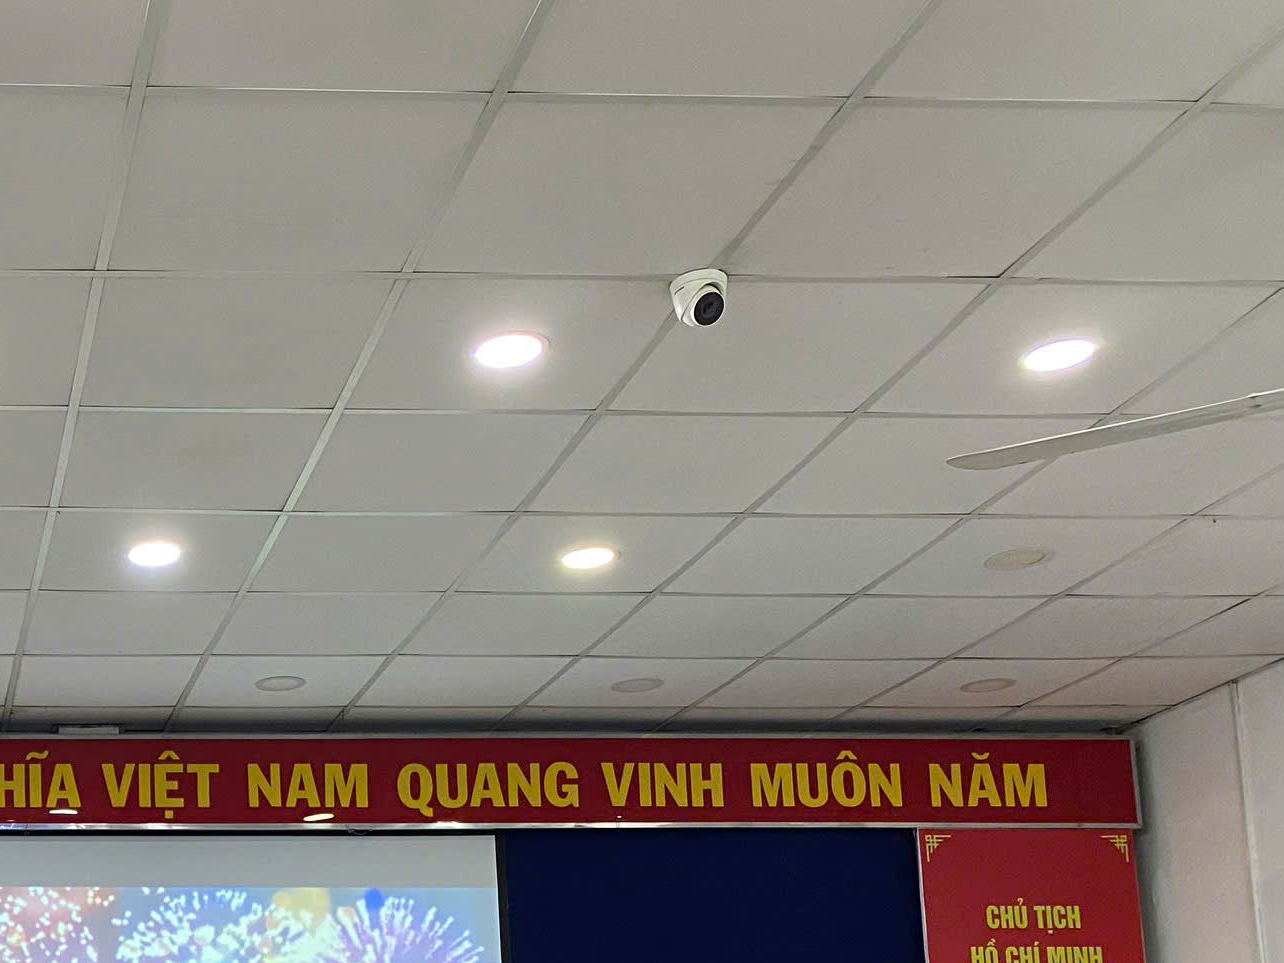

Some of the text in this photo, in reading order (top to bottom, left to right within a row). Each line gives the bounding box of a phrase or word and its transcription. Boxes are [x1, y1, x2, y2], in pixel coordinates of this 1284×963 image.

[102, 751, 219, 819] VIỆT
[248, 763, 368, 807] NAM
[397, 762, 579, 816] QUANG
[601, 762, 724, 807] VINH
[751, 751, 902, 807] MUÔN
[929, 751, 1048, 807] NĂM
[986, 898, 1082, 934] CHỦ TỊCH
